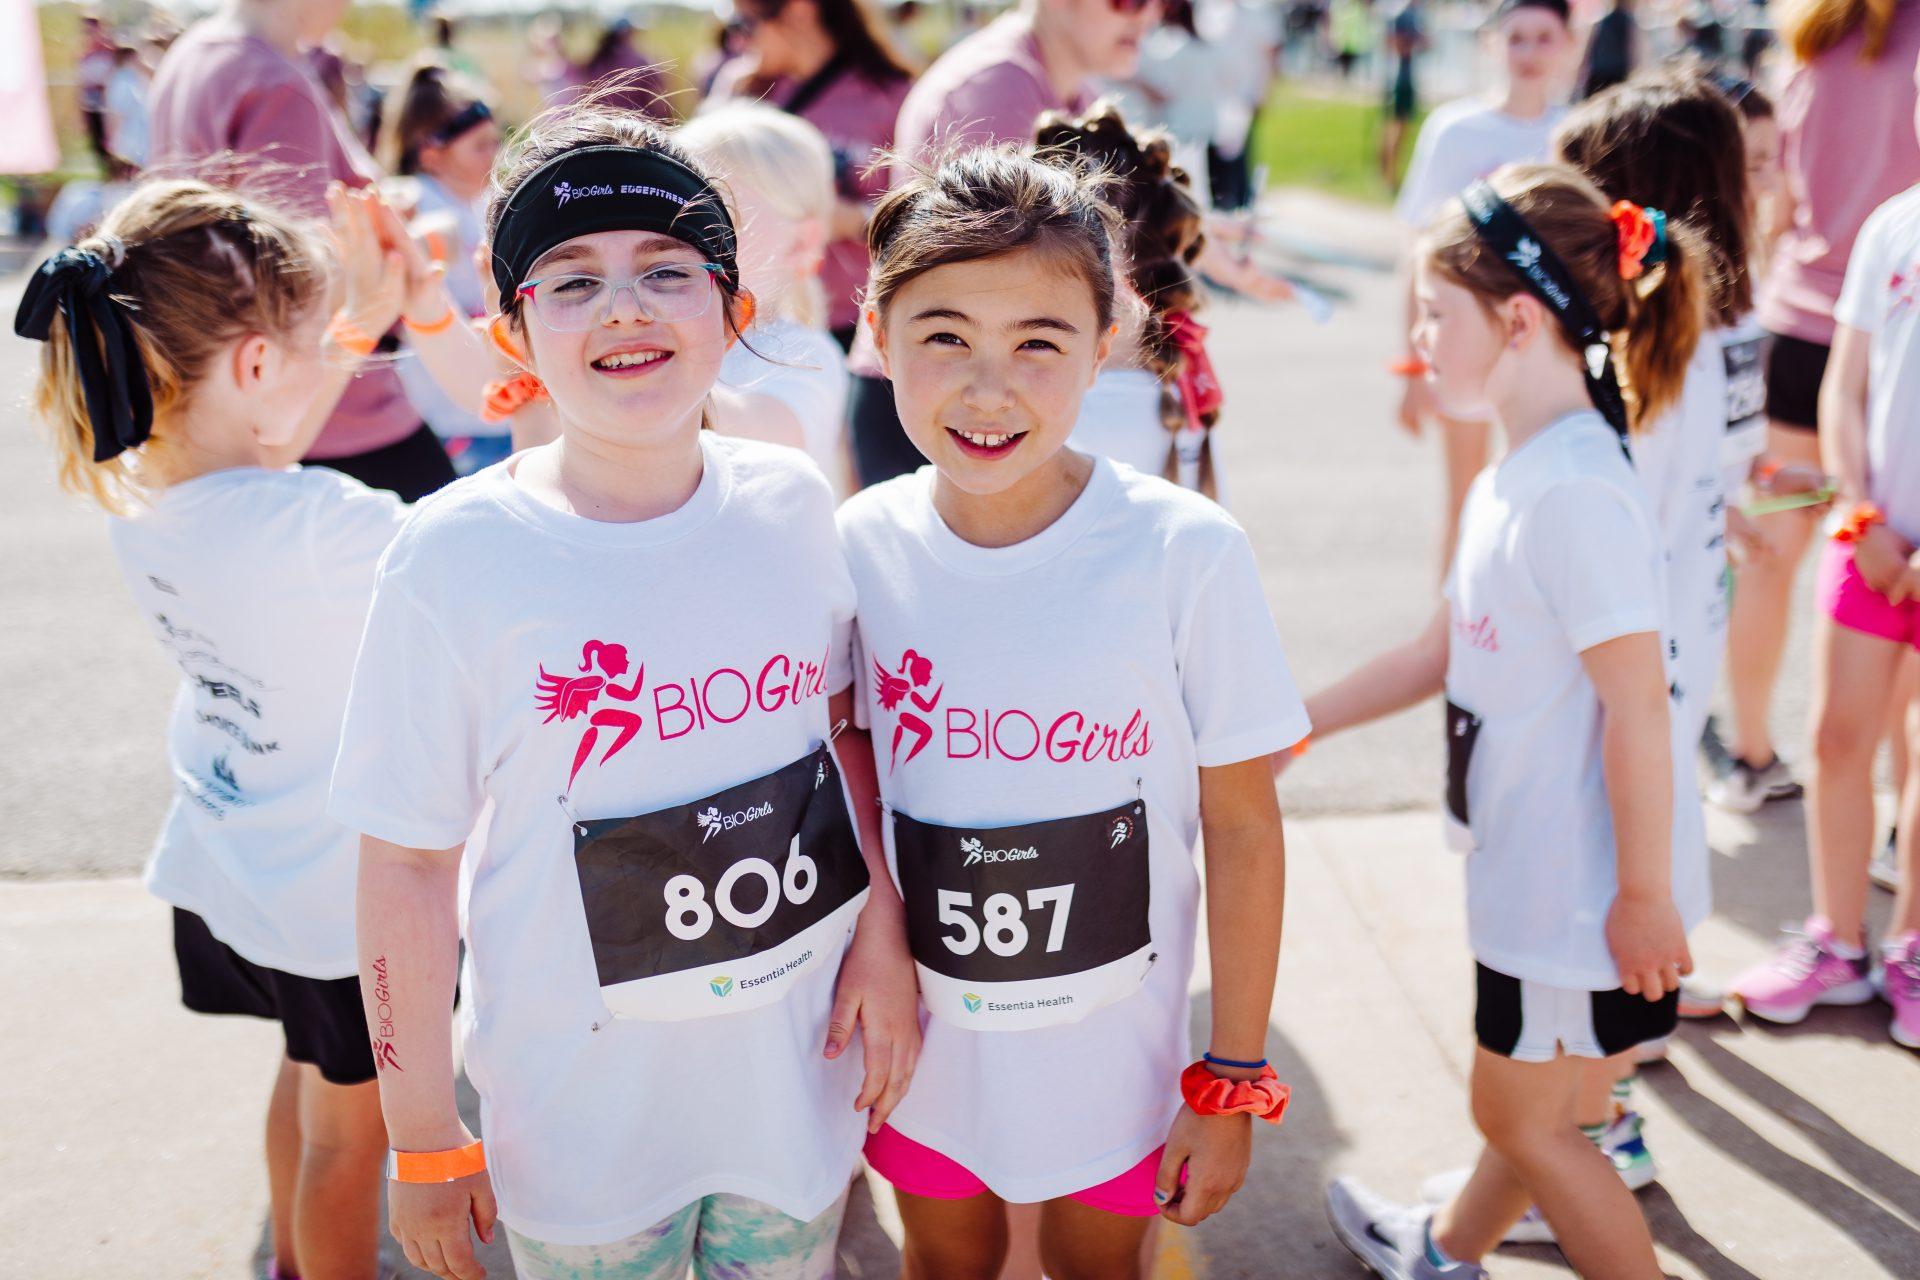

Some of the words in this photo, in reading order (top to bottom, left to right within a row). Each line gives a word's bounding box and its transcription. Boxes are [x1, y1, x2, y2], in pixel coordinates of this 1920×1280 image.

[572, 184, 614, 199] BIOGirls
[653, 642, 830, 741] BIOGirl
[946, 707, 1154, 763] BIOGirls
[722, 801, 774, 831] BIOGirls
[983, 846, 1040, 864] BIOGirls
[663, 832, 818, 941] 806
[937, 883, 1075, 957] 587
[740, 967, 785, 990] Essentia
[786, 949, 813, 972] Health
[372, 955, 395, 1038] BIOGirls
[987, 1000, 1035, 1012] Essentia
[1037, 994, 1074, 1009] Health
